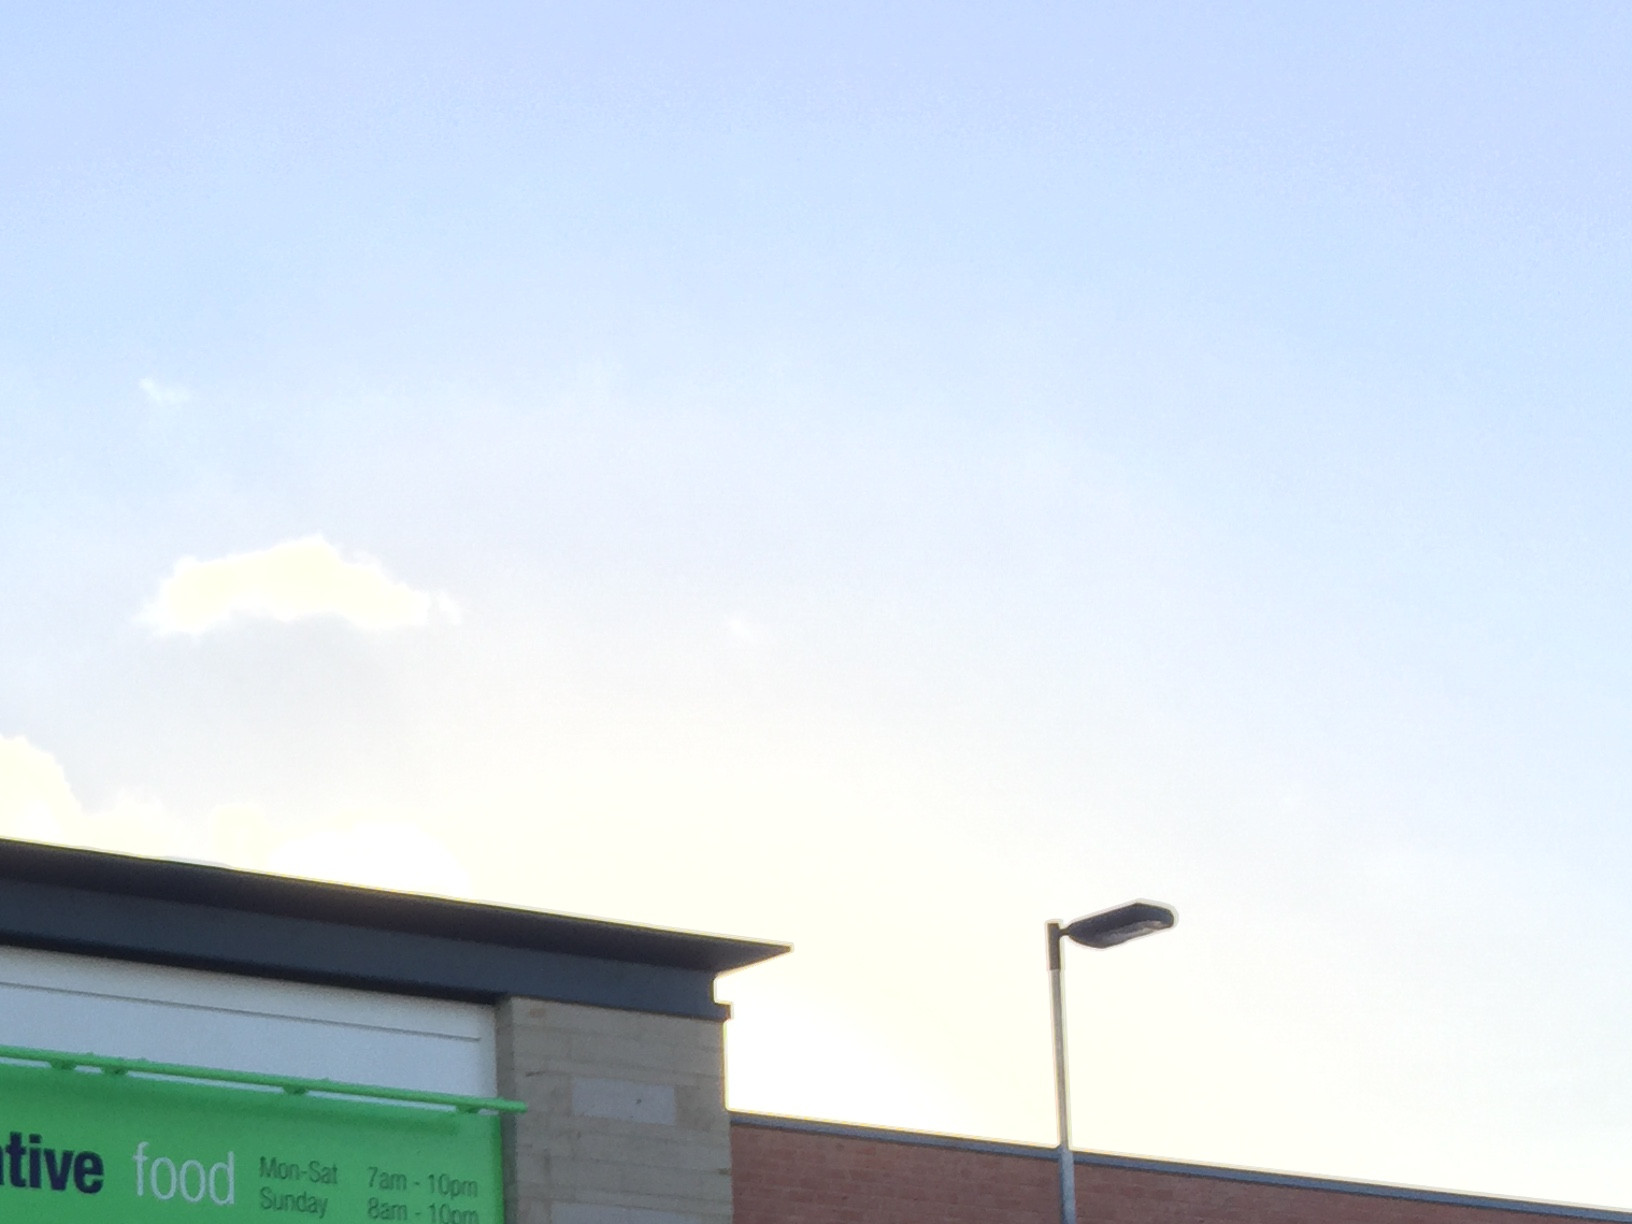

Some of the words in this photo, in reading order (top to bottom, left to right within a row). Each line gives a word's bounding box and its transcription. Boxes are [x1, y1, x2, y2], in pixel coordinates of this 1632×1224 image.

[131, 1140, 236, 1207] food
[258, 1155, 339, 1186] Mon-Sat
[367, 1165, 408, 1192] 7am
[427, 1173, 480, 1201] 10pm
[258, 1186, 329, 1220] Sunday
[366, 1196, 409, 1222] 8am
